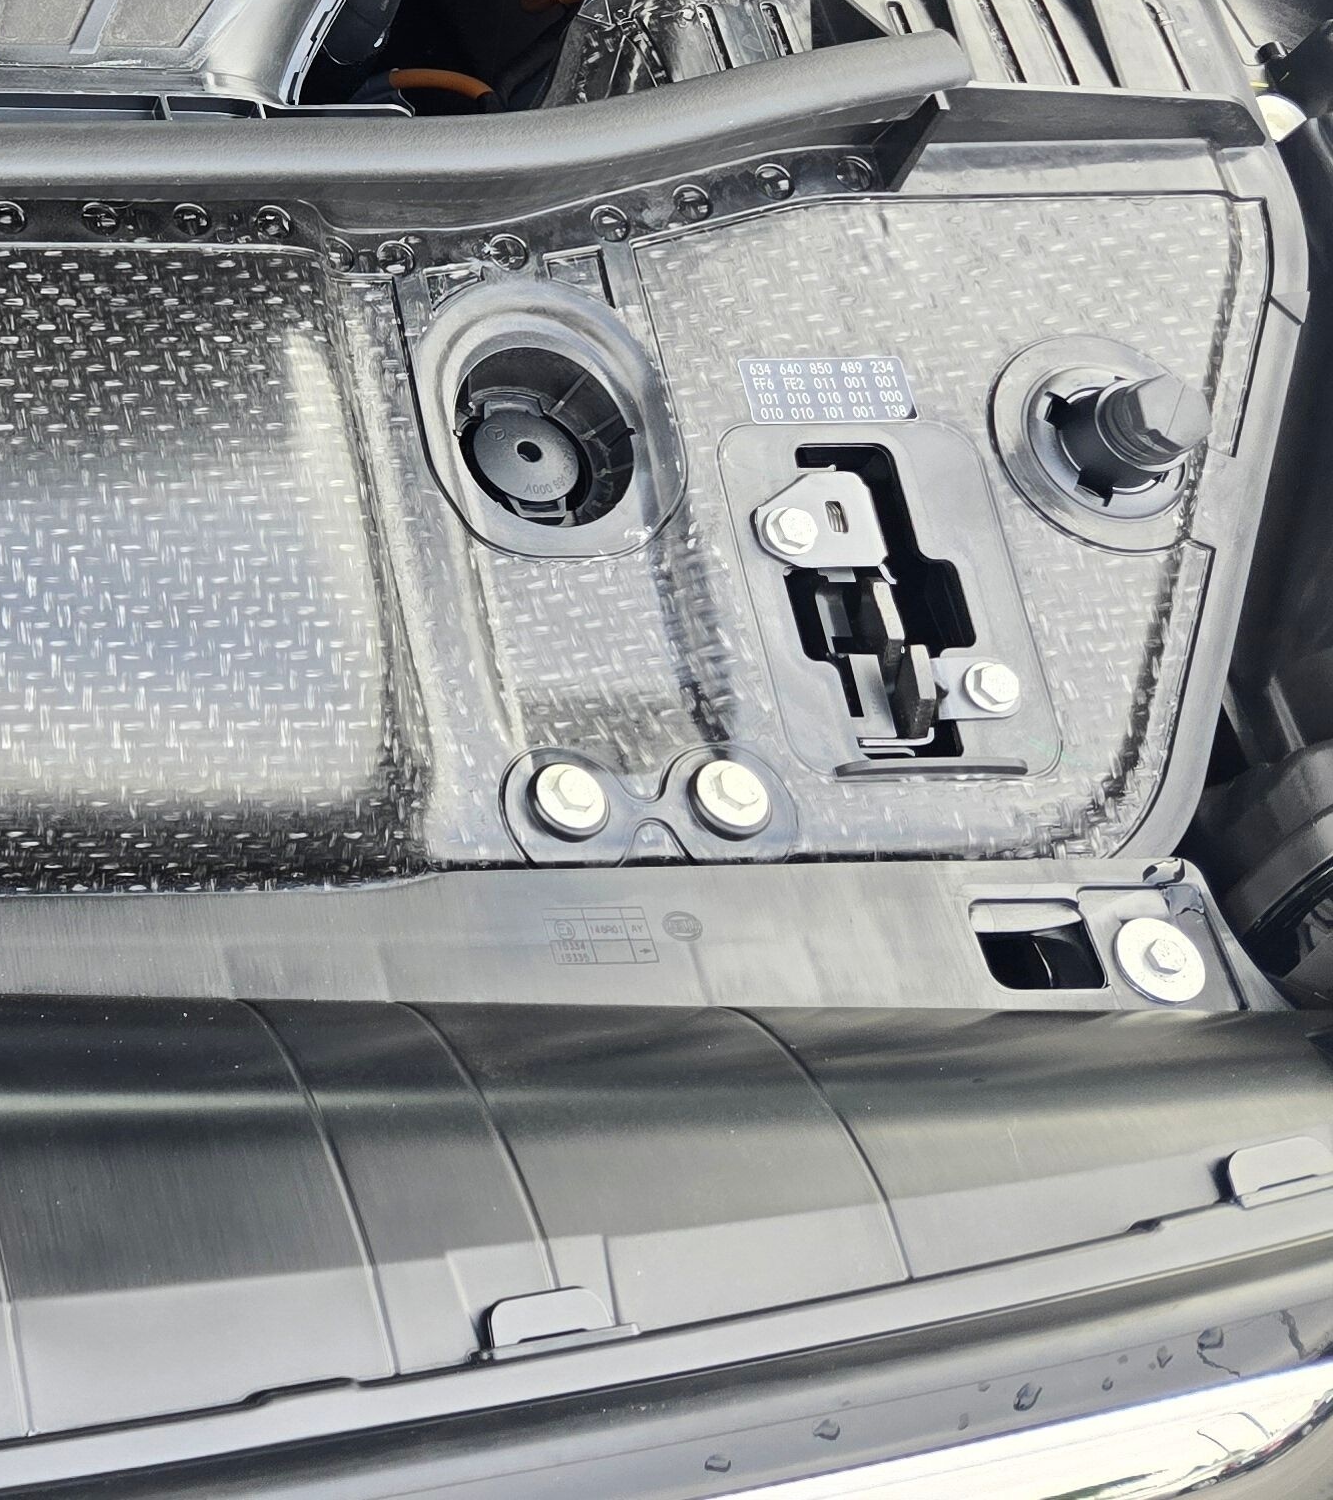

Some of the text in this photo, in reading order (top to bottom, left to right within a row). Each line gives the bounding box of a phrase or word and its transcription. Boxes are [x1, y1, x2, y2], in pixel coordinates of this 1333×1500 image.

[749, 361, 894, 375] 634 640 850 489 234
[753, 375, 898, 390] FF6 FE2 011 001 001
[758, 390, 903, 405] 101 010 010 011 000
[760, 405, 907, 420] 010 010 101 001 138
